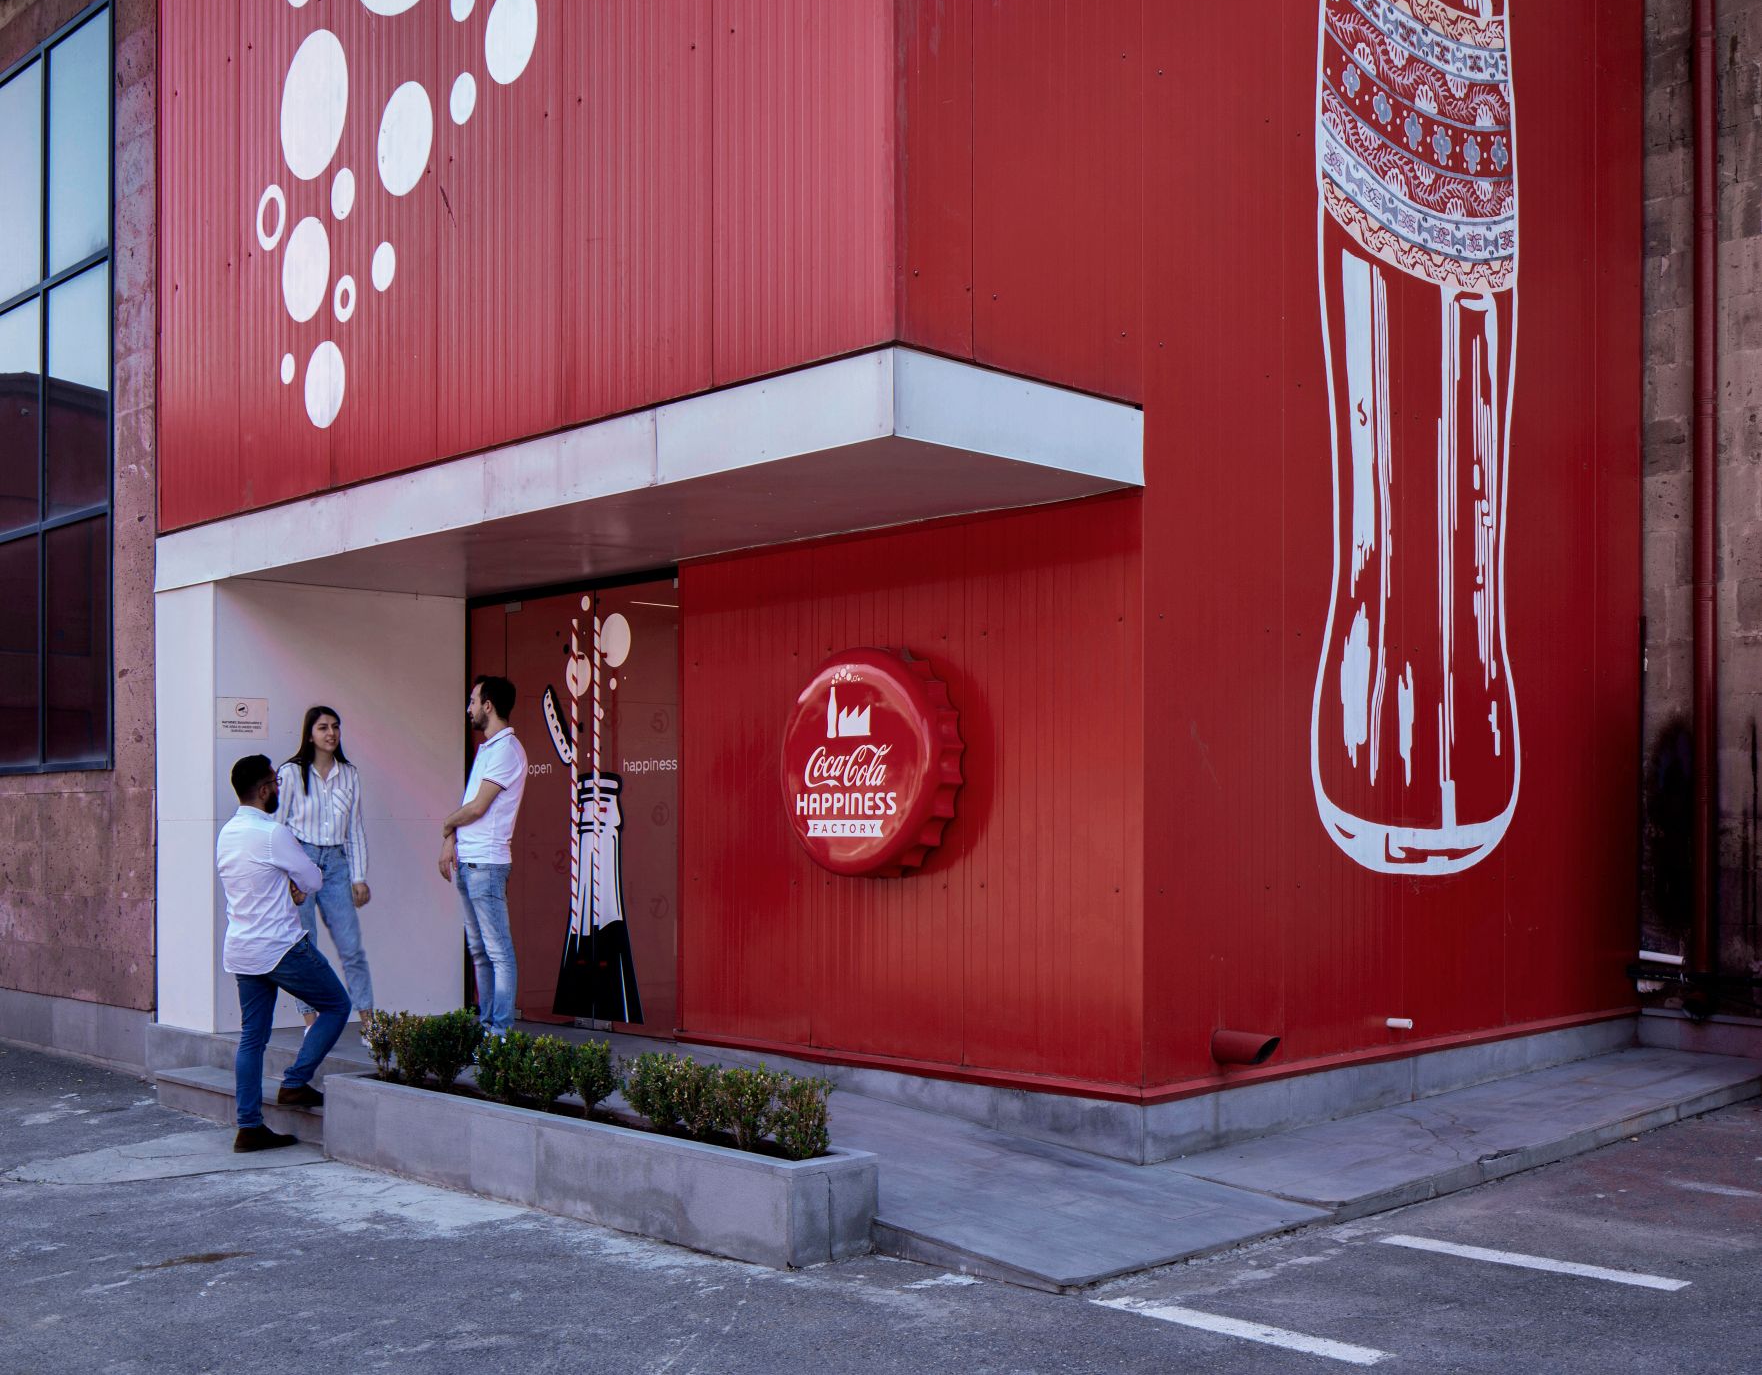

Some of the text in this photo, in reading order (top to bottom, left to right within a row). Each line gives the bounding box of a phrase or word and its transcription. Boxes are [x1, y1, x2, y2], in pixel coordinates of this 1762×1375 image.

[528, 757, 678, 777] open happiness
[804, 744, 893, 789] Coca-Cola
[796, 791, 897, 816] HAPPINESS
[812, 823, 877, 834] FACTORY
